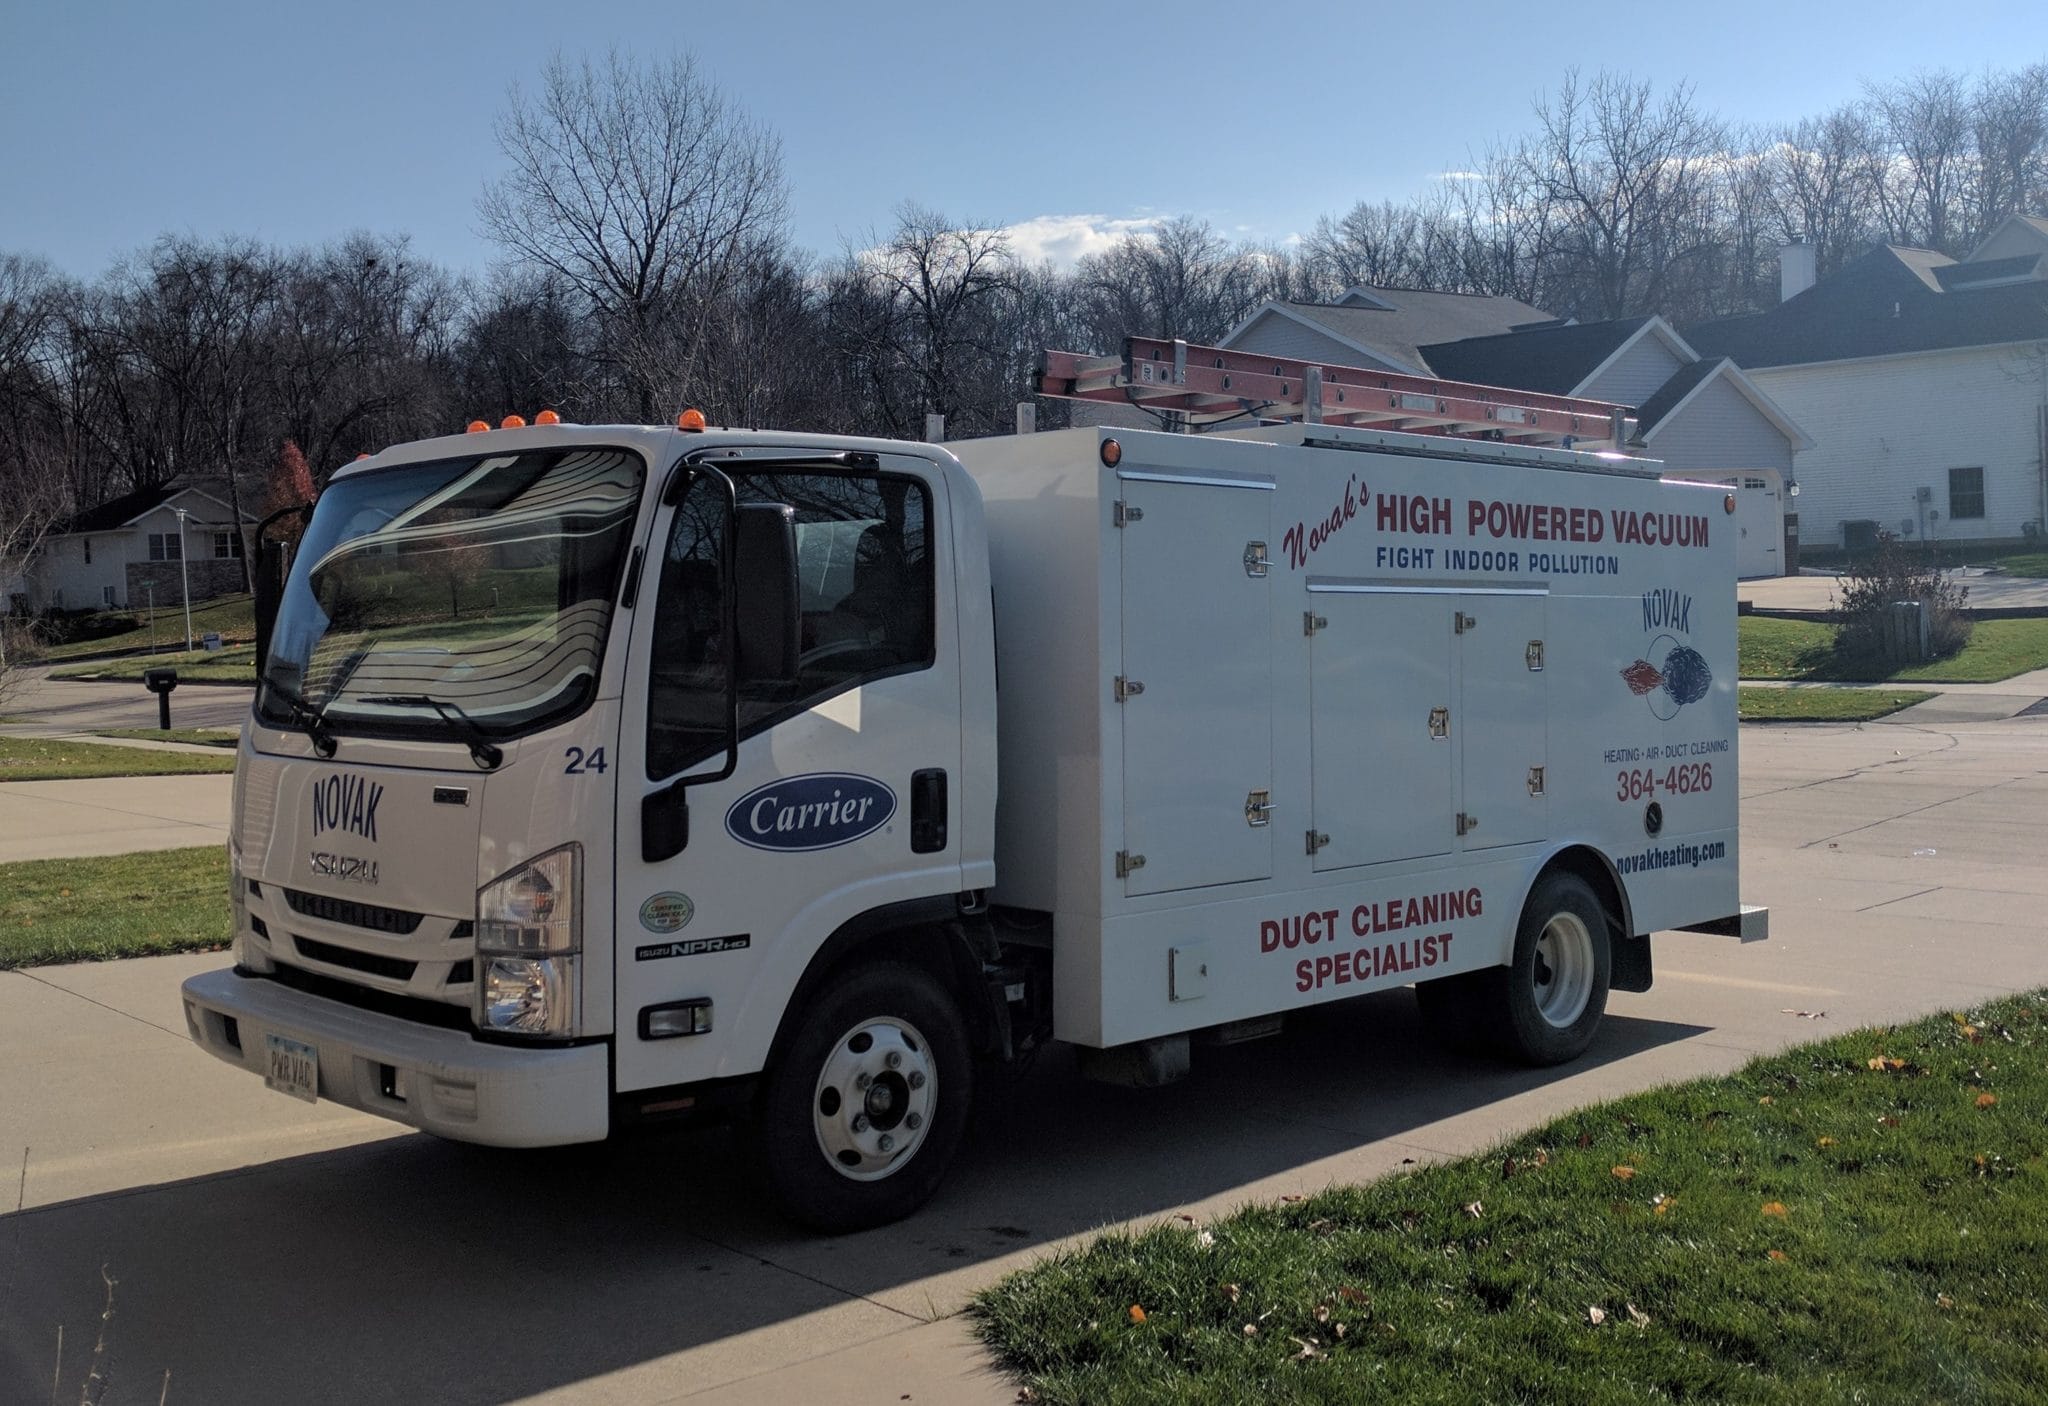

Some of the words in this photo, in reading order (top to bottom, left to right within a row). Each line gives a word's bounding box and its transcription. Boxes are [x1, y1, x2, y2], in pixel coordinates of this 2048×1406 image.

[1283, 474, 1370, 570] Novak's
[1376, 493, 1452, 535] HIGH
[1468, 500, 1604, 543] POWERED
[1611, 509, 1710, 548] VACUUM
[1376, 547, 1434, 570] FIGHT
[1445, 549, 1519, 573] INDOOR
[1529, 553, 1619, 575] POLLUTION
[1642, 588, 1692, 634] NOVAK
[564, 746, 608, 775] 24
[1604, 748, 1640, 764] HEATING
[1646, 746, 1659, 760] AIR
[1665, 743, 1688, 758] DUCT
[1691, 739, 1729, 756] CLEANING
[1617, 762, 1712, 802] 364-4626
[313, 774, 384, 842] NOVAK
[750, 789, 873, 834] Carrier
[310, 852, 378, 885] ISUZU
[1616, 840, 1725, 875] novakheating.com
[1260, 909, 1339, 953] DUCT
[1352, 887, 1483, 937] CLEANING
[640, 947, 670, 958] ISUZU
[671, 939, 723, 956] NPR
[1295, 932, 1454, 993] SPECIALIST
